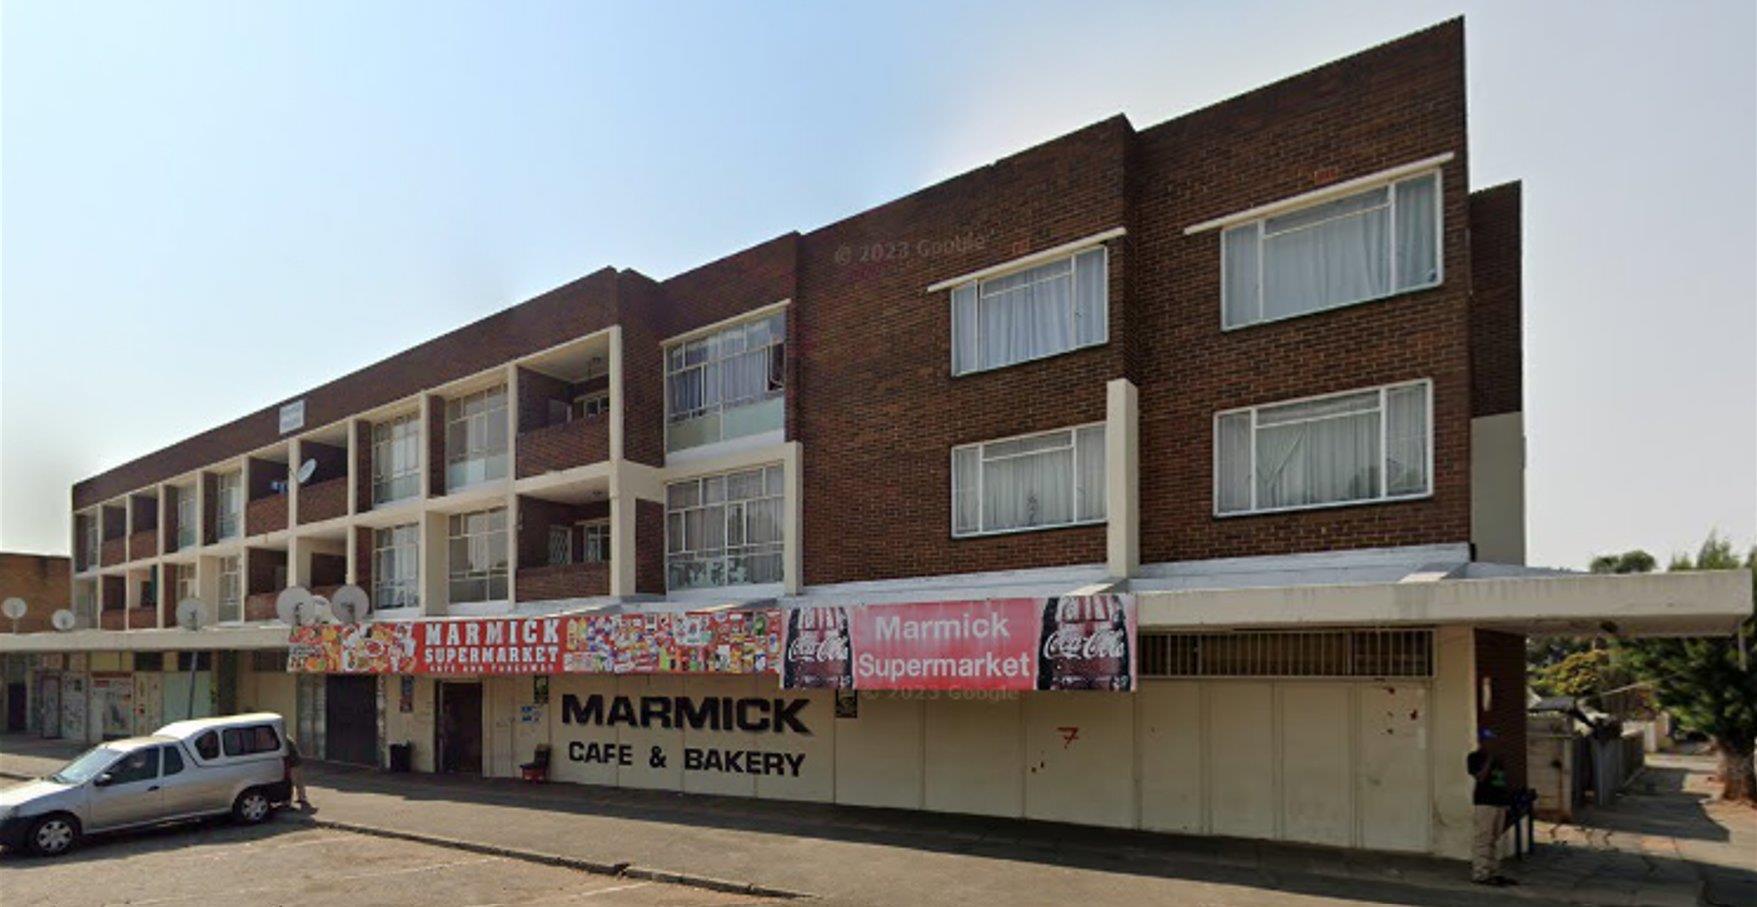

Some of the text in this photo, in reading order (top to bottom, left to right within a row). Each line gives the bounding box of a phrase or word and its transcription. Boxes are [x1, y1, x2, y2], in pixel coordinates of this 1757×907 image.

[425, 619, 559, 646] MARMICK
[875, 612, 1009, 641] Marmick
[424, 646, 558, 663] SUPERMARKET
[859, 653, 1030, 681] Supermarket
[562, 693, 813, 735] MARMICK
[569, 741, 806, 777] CAFE & BAKERY
